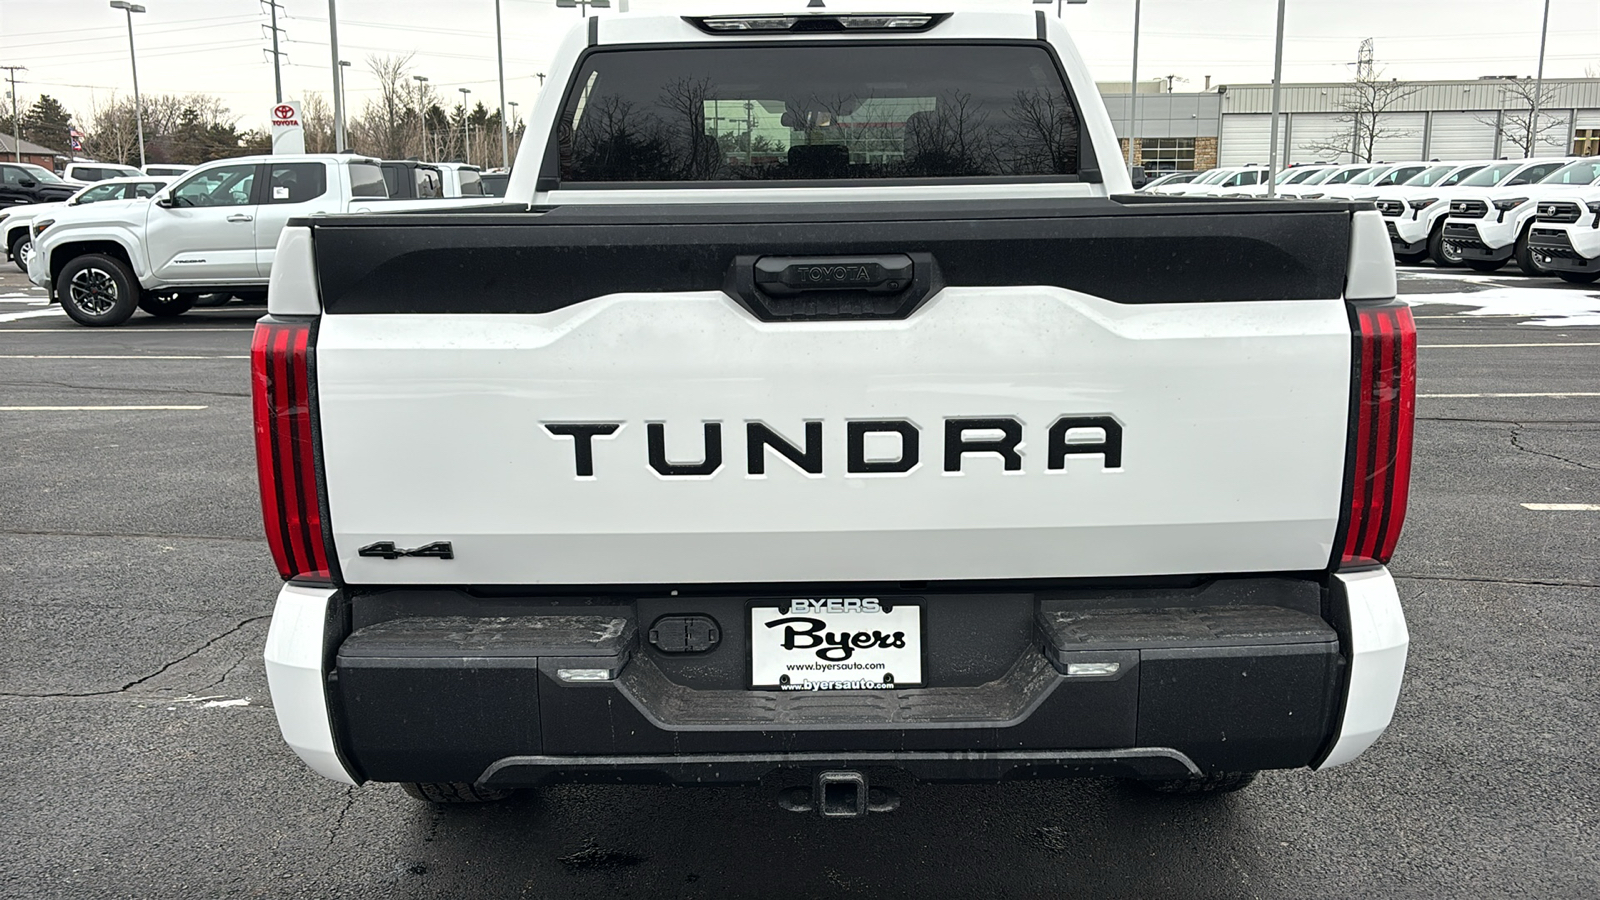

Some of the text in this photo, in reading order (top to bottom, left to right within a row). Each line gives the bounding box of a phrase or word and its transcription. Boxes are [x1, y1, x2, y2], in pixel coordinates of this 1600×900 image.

[798, 266, 870, 281] TOYOTA
[542, 414, 1124, 477] TUNDRA
[791, 598, 880, 614] BYERS
[764, 616, 906, 662] Byers
[786, 661, 886, 673] www.byersauto.com
[780, 678, 895, 692] www.byersauto.com
